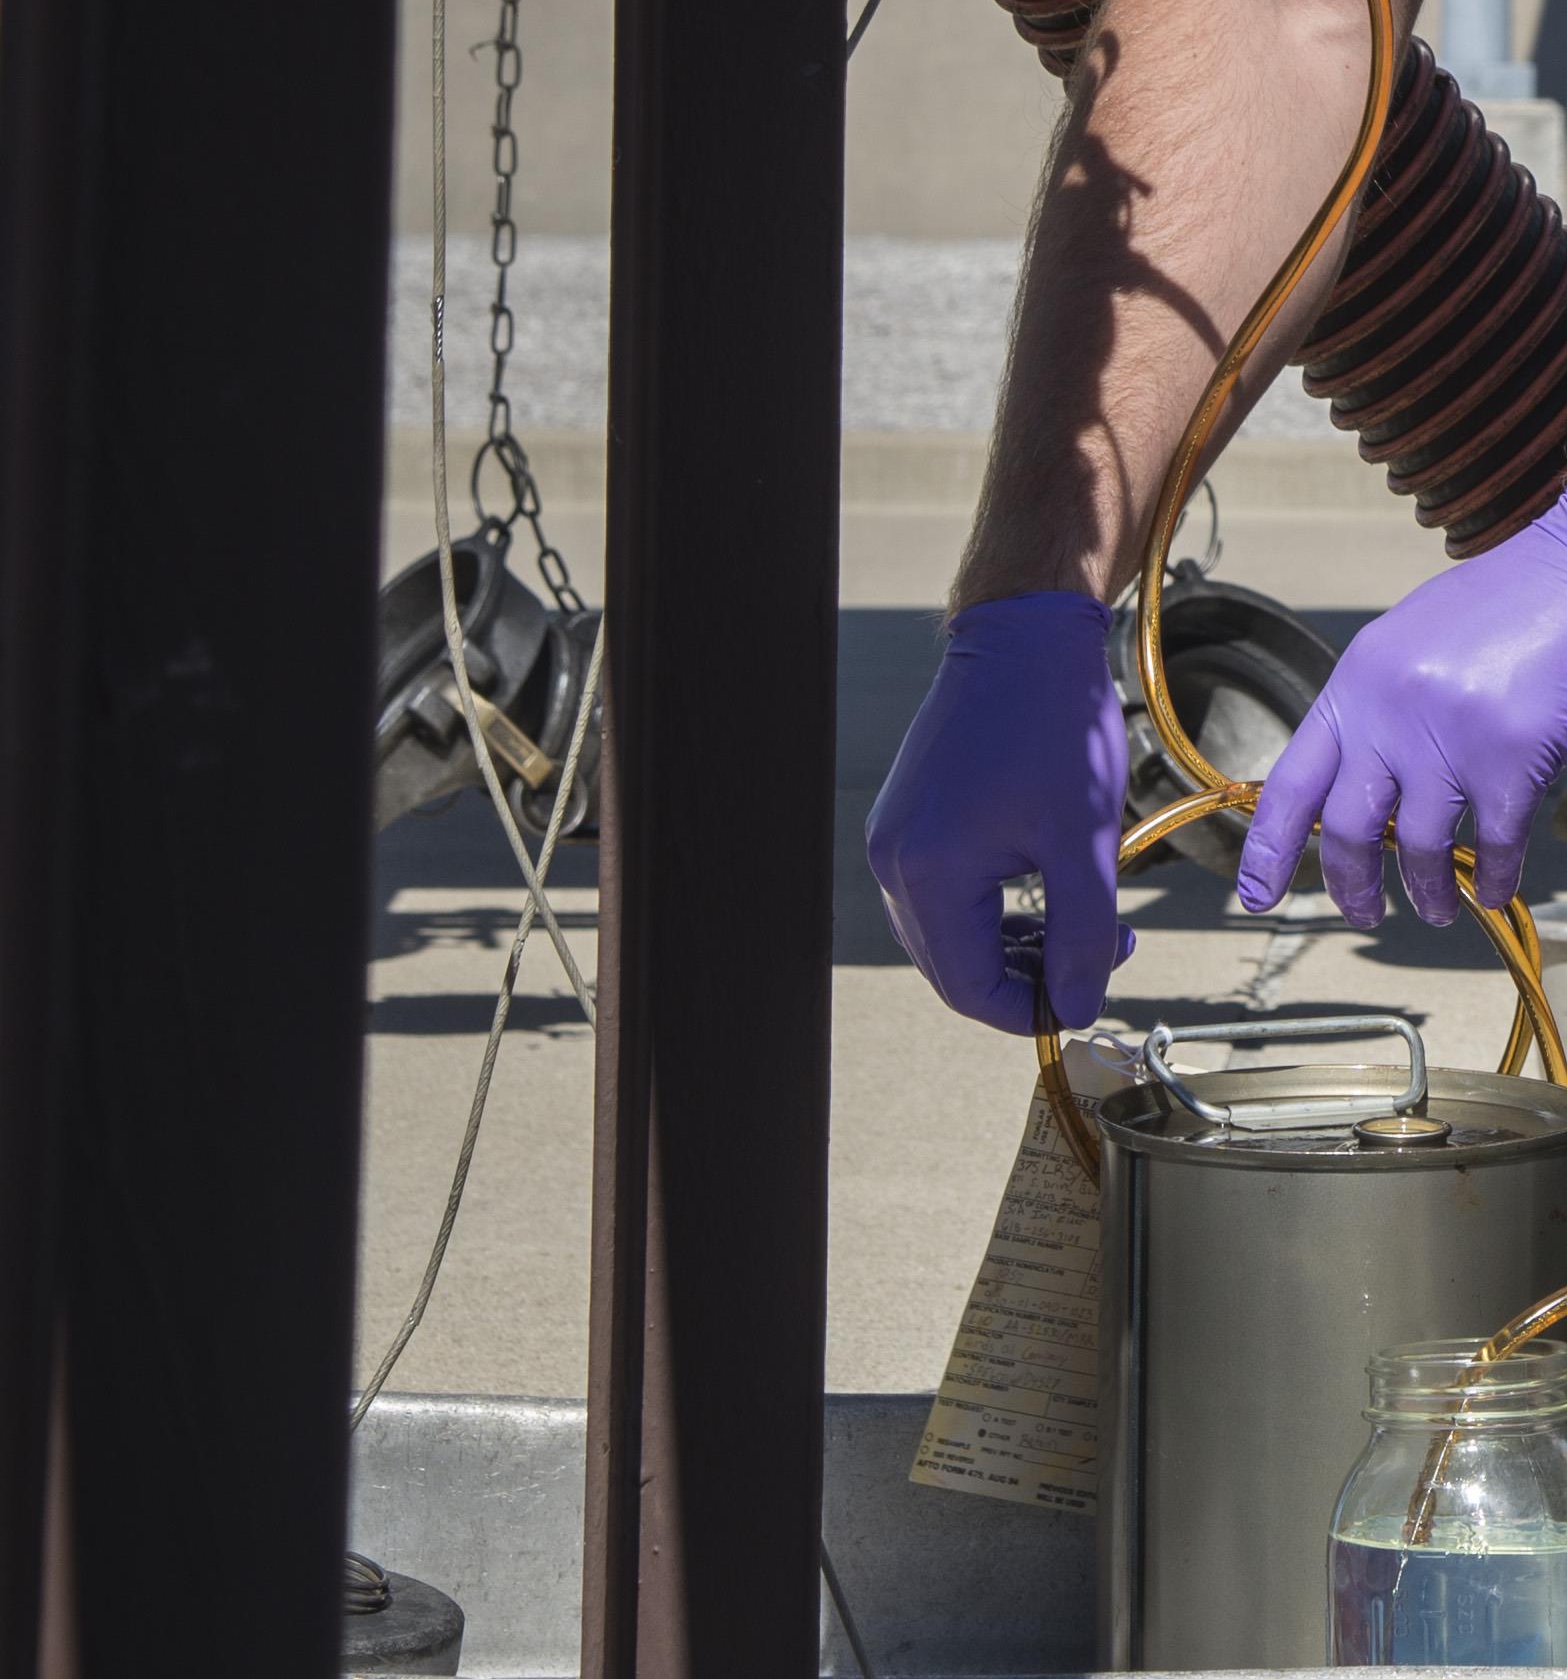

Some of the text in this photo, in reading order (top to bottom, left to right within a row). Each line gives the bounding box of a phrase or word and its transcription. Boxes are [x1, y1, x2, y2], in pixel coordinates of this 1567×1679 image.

[1017, 1159, 1040, 1175] 375
[1037, 1241, 1064, 1251] NUMBER
[1016, 1262, 1065, 1277] NOMENCLATURE
[952, 1351, 1016, 1368] CONTRACT NUMBER
[916, 1459, 941, 1472] AFTO
[941, 1463, 967, 1476] FORM
[987, 1473, 1007, 1486] AUG
